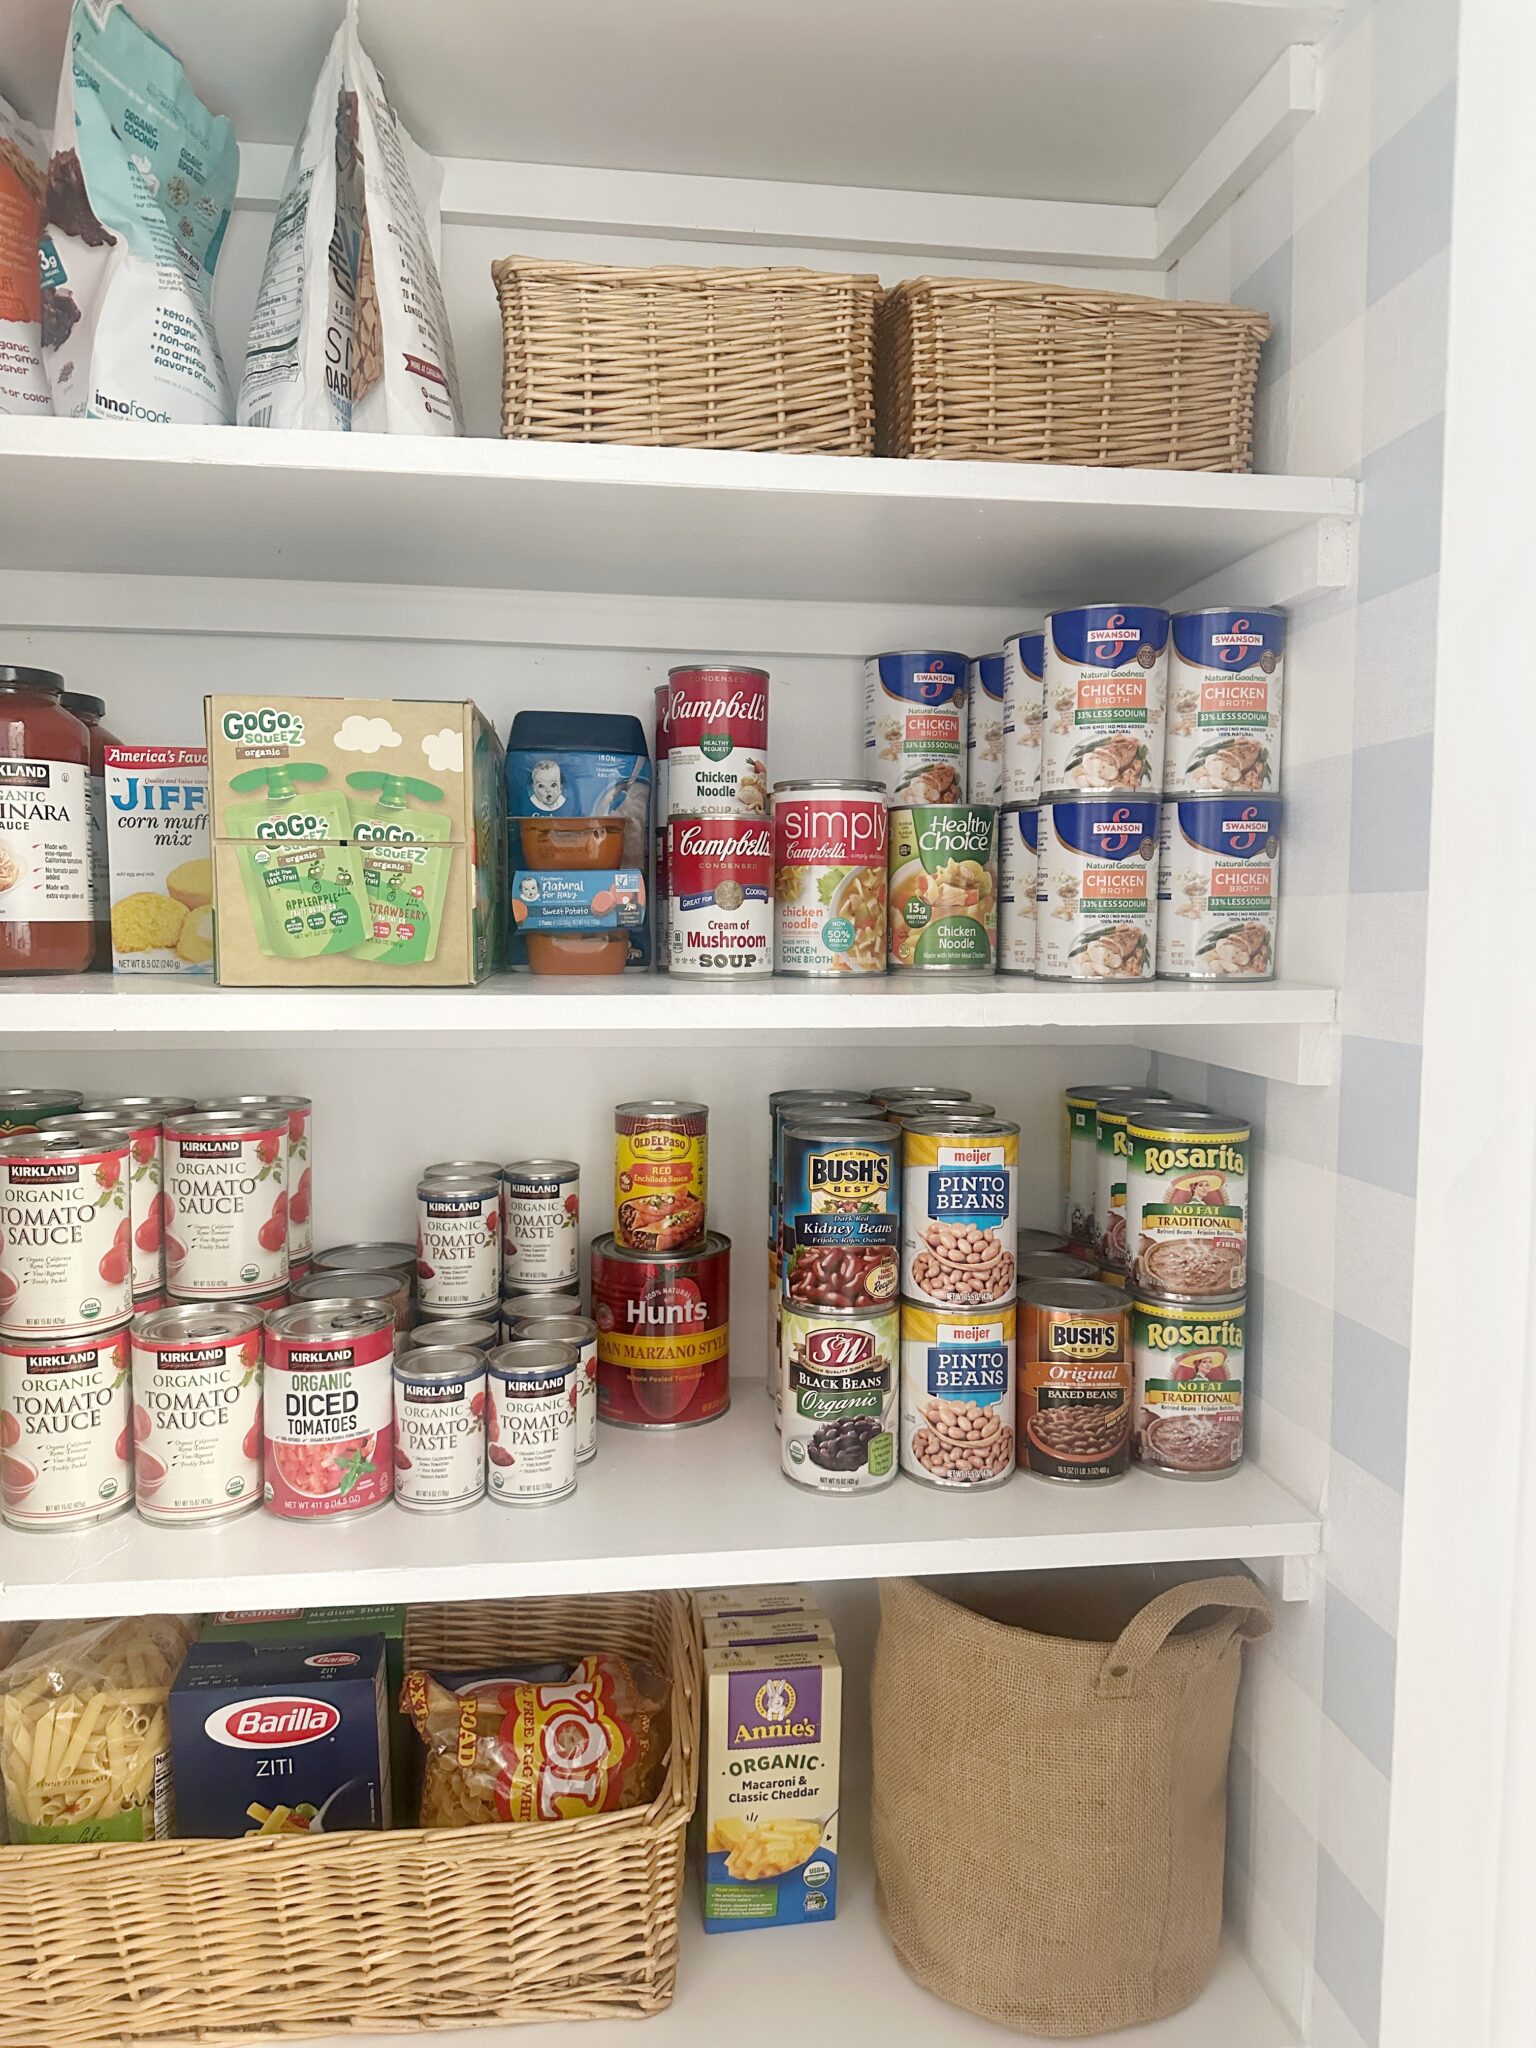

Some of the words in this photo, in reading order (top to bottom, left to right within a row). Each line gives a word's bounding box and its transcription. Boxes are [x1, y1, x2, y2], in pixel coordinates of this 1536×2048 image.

[124, 108, 158, 138] ORGANIC
[123, 122, 159, 151] COCONUT
[163, 307, 185, 322] keto
[161, 320, 198, 342] organic
[154, 356, 193, 376] flavors
[1091, 631, 1137, 640] SWANSON
[1081, 684, 1142, 697] CHICKEN
[1205, 687, 1264, 699] CHICKEN
[672, 690, 765, 724] Campbell's
[1077, 710, 1091, 719] 33%
[1093, 709, 1112, 718] LESS
[1114, 708, 1146, 718] SODIUM
[223, 709, 291, 740] GoGo
[909, 718, 957, 731] CHICKEN
[108, 749, 175, 763] America's
[245, 748, 280, 758] organic
[598, 754, 616, 762] IRON
[695, 771, 738, 784] Chicken
[697, 785, 736, 797] Noodle
[0, 803, 70, 821] INARA
[118, 816, 159, 829] corn
[164, 814, 209, 830] muff
[785, 805, 887, 850] simply
[930, 812, 992, 836] Healthy
[154, 830, 192, 846] mix
[681, 825, 771, 861] Campbell's
[919, 831, 989, 851] Choice
[286, 852, 317, 862] organic
[786, 842, 847, 862] Campbell's
[373, 861, 405, 871] organic
[1087, 875, 1144, 887] CHICKEN
[1216, 873, 1269, 885] CHICKEN
[286, 893, 339, 911] APPLEAPPLE
[682, 899, 701, 908] GREAT
[702, 895, 713, 904] FOR
[782, 906, 823, 917] chicken
[782, 920, 818, 930] noodle
[937, 925, 976, 937] Chicken
[687, 932, 766, 948] Mushroom
[939, 938, 975, 949] Noodle
[119, 960, 130, 969] NET
[131, 960, 140, 969] WT
[141, 960, 151, 969] 8.5
[699, 954, 757, 968] SOUP
[182, 1141, 240, 1152] KIRKLAND
[634, 1138, 650, 1148] OLD
[954, 1149, 991, 1164] meijer
[1145, 1145, 1244, 1175] Rosarita
[12, 1165, 76, 1177] KIRKLAND
[176, 1162, 246, 1175] ORGANIC
[813, 1157, 888, 1186] BUSH'S
[170, 1178, 256, 1197] TOMATO
[512, 1184, 558, 1193] KIRKLAND
[939, 1177, 1004, 1191] PINTO
[5, 1187, 84, 1203] ORGANIC
[937, 1194, 1004, 1209] BEANS
[179, 1197, 244, 1214] SAUCE
[429, 1202, 480, 1212] KIRKLAND
[511, 1202, 559, 1211] ORGANIC
[428, 1220, 481, 1231] ORGANIC
[1158, 1217, 1231, 1228] TRADITIONAL
[8, 1225, 82, 1246] SAUCE
[515, 1227, 554, 1239] PASTE
[432, 1246, 476, 1260] PASTE
[645, 1290, 661, 1301] 100%
[662, 1287, 691, 1299] NATURAL
[954, 1327, 990, 1342] meijer
[1054, 1326, 1114, 1346] BUSH'S
[1148, 1321, 1243, 1350] Rosarita
[160, 1349, 223, 1363] KIRKLAND
[291, 1350, 352, 1363] KIRKLAND
[600, 1340, 620, 1355] SAN
[624, 1343, 696, 1360] MARZANO
[29, 1351, 96, 1367] KIRKLAND
[939, 1353, 1003, 1369] PINTO
[22, 1372, 103, 1391] ORGANIC
[153, 1370, 230, 1387] ORGANIC
[292, 1372, 352, 1392] ORGANIC
[799, 1372, 838, 1390] BLACK
[842, 1376, 881, 1390] BEANS
[936, 1370, 1003, 1386] BEANS
[1049, 1366, 1118, 1382] Original
[406, 1385, 463, 1396] KIRKLAND
[508, 1377, 563, 1391] KIRKLAND
[13, 1388, 113, 1416] TOMATO
[145, 1386, 240, 1411] TOMATO
[286, 1391, 359, 1417] DICED
[506, 1397, 565, 1412] ORGANIC
[801, 1390, 877, 1419] Organic
[1162, 1393, 1232, 1403] TRADITIONAL
[157, 1407, 229, 1430] SAUCE
[405, 1405, 464, 1419] ORGANIC
[26, 1409, 101, 1434] SAUCE
[288, 1415, 357, 1436] TOMATOES
[409, 1435, 457, 1451] PASTE
[512, 1428, 559, 1445] PASTE
[309, 1608, 355, 1617] Medium
[360, 1605, 395, 1614] Shells
[237, 1708, 328, 1735] Barilla
[523, 1701, 536, 1737] FREE
[458, 1697, 478, 1768] ROAD
[735, 1718, 816, 1744] Annie's
[537, 1683, 609, 1821] YOL
[256, 1759, 294, 1777] ZITI
[522, 1742, 535, 1779] EGG
[729, 1754, 819, 1776] ORGANIC
[742, 1776, 796, 1790] Macaroni
[798, 1776, 807, 1785] &
[520, 1784, 535, 1821] WHI
[729, 1791, 768, 1803] Classic
[771, 1787, 819, 1800] Cheddar
